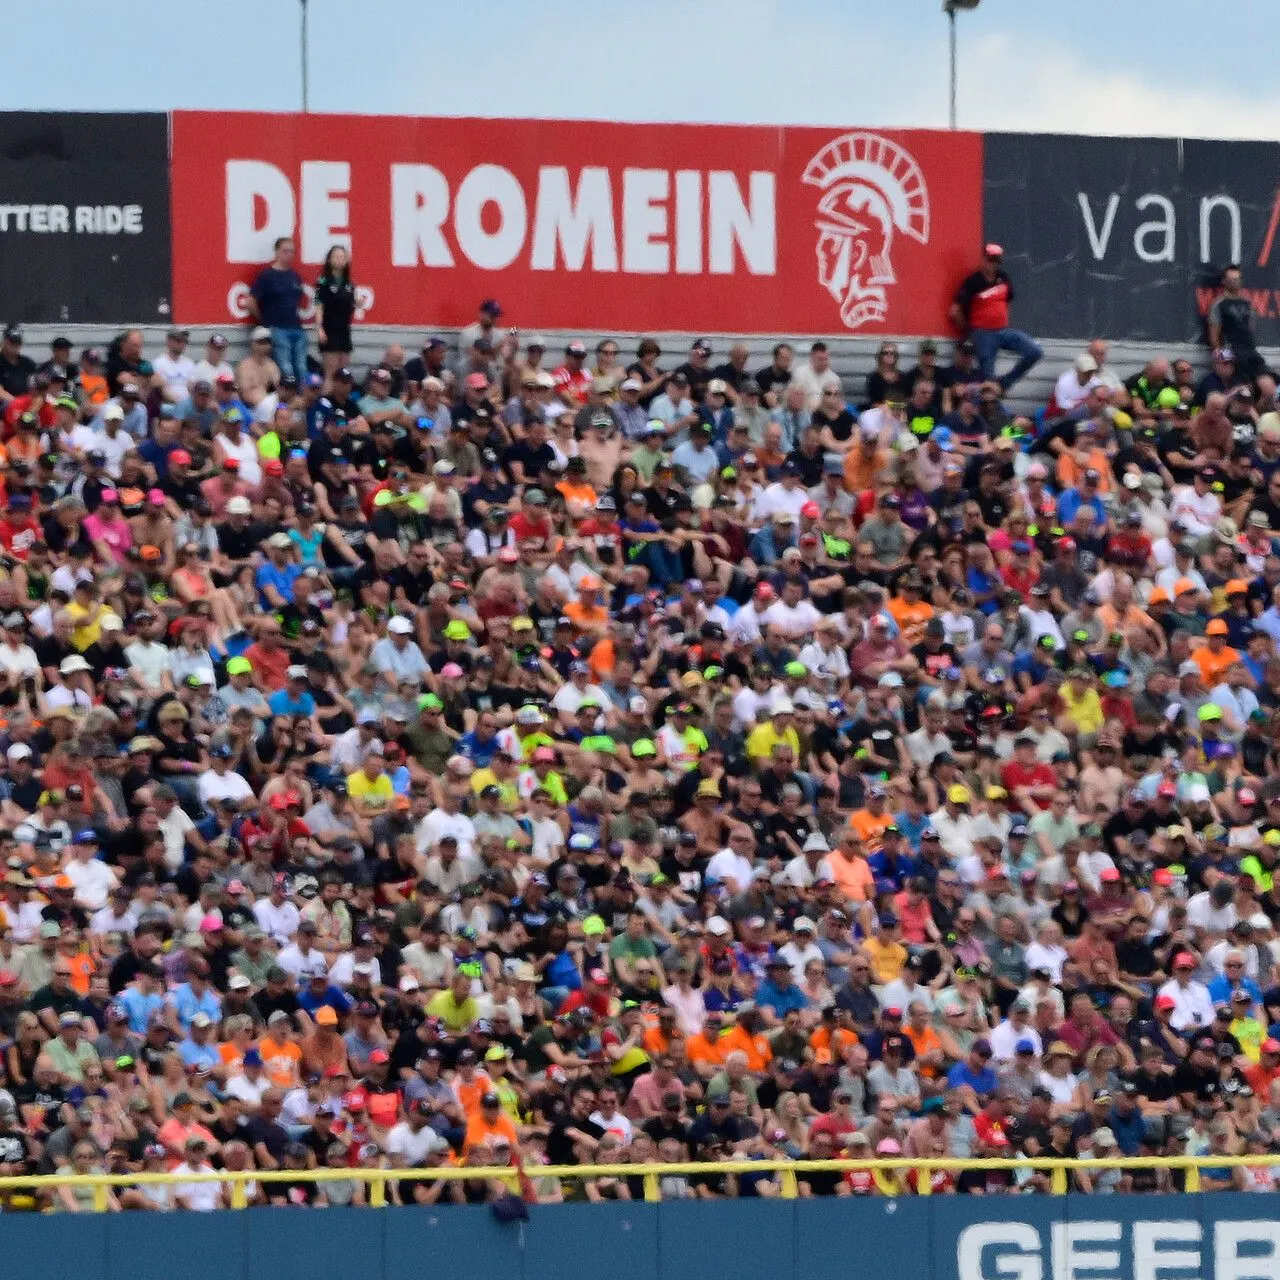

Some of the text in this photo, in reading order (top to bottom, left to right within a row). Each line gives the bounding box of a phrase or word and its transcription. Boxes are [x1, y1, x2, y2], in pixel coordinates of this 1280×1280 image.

[75, 205, 143, 234] RIDE
[226, 159, 777, 276] DE ROMEIN
